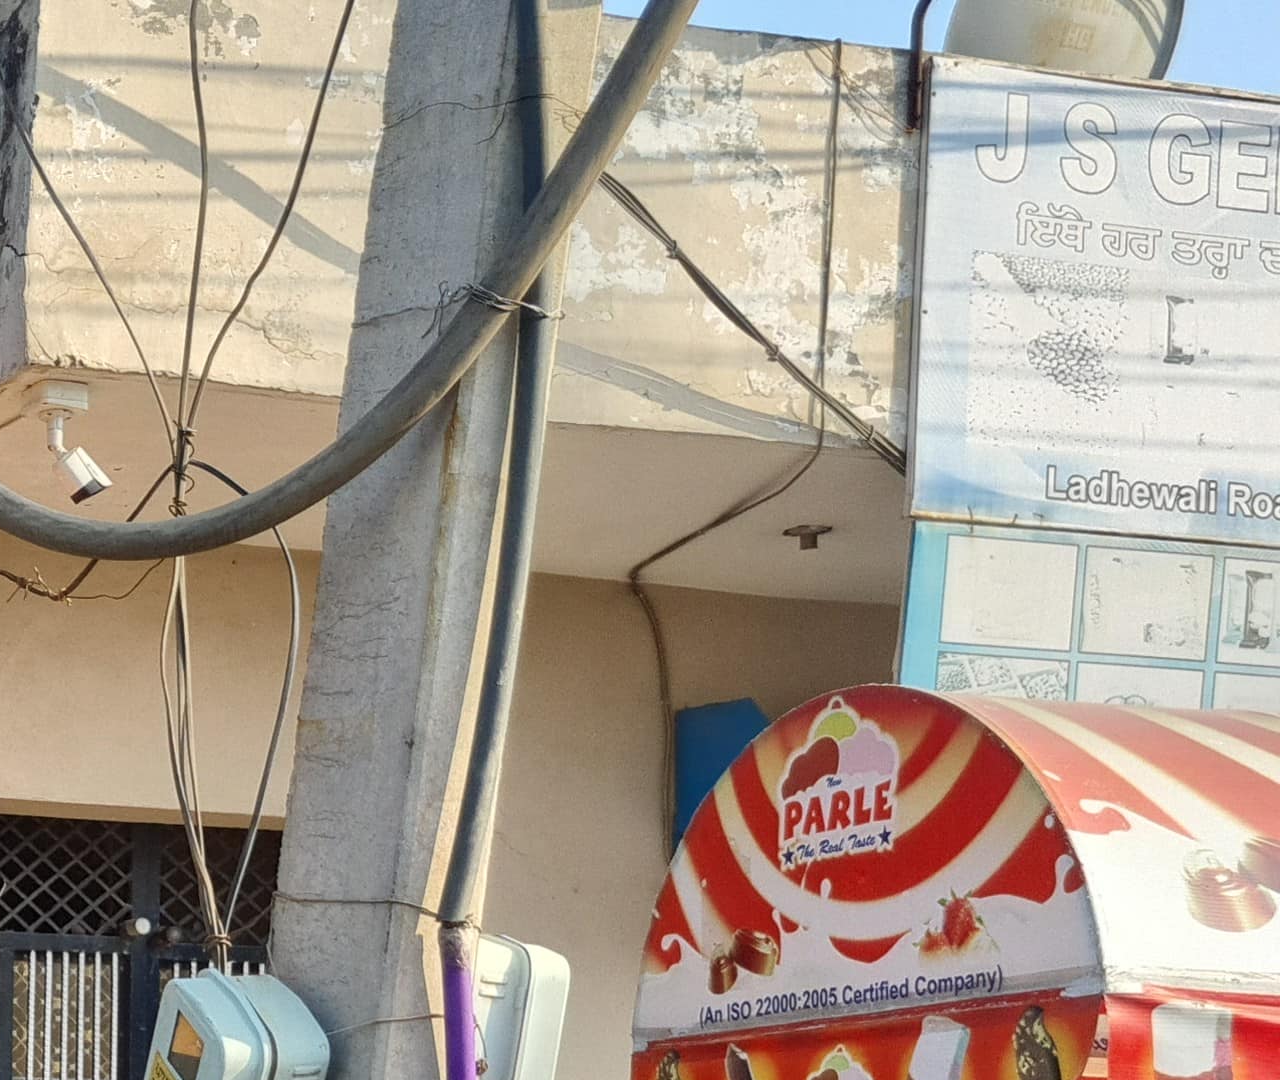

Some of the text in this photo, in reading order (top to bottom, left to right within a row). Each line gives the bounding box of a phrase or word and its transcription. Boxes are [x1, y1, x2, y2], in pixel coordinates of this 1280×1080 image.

[975, 93, 1280, 215] J S GE
[1102, 222, 1162, 261] ਹਰ
[1044, 464, 1218, 515] Ladhewali
[783, 779, 893, 841] PARLE
[796, 834, 876, 860] The Real Taste
[727, 1001, 752, 1022] ISO
[755, 988, 838, 1015] 22000:2005
[842, 978, 910, 1005] Certified
[914, 965, 1004, 995] Company)
